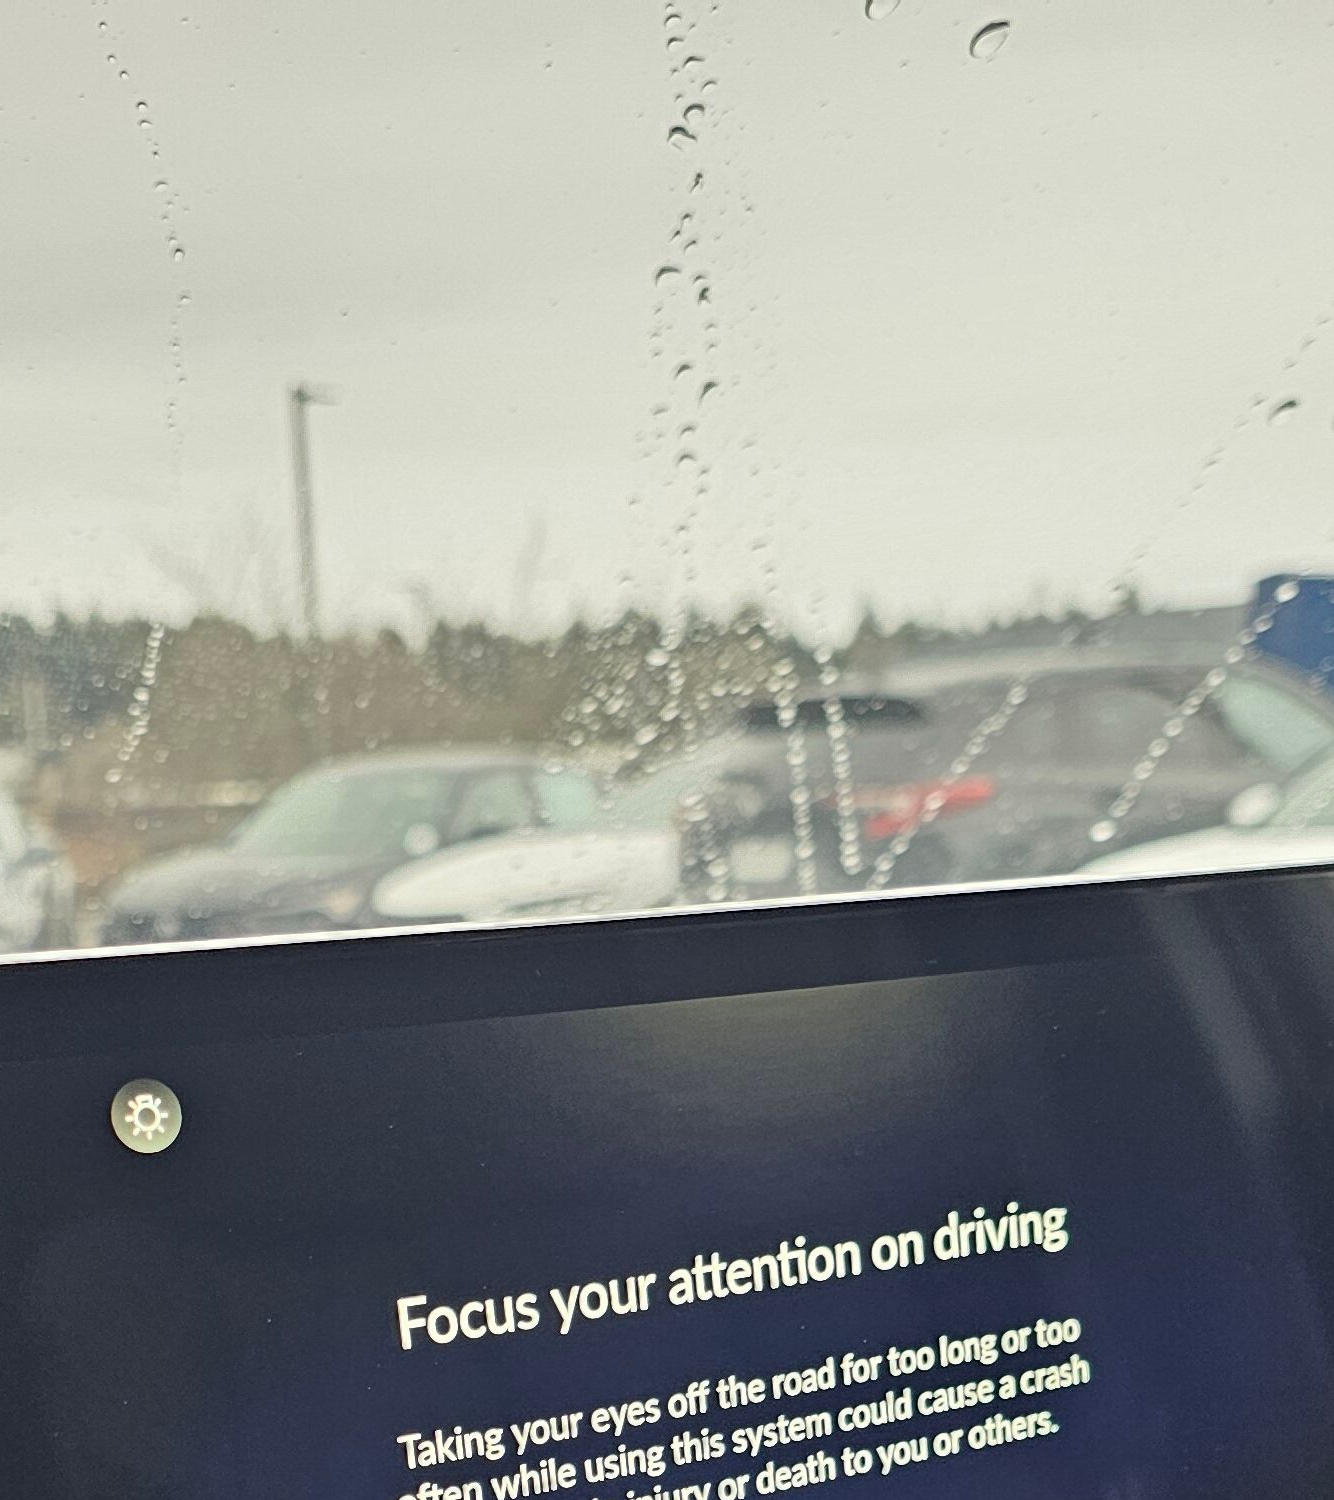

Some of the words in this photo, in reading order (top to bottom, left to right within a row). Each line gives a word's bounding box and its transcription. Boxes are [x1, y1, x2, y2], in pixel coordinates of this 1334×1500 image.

[396, 1294, 540, 1350] Focus
[549, 1273, 657, 1335] your
[668, 1235, 861, 1305] attention
[871, 1230, 924, 1271] on
[933, 1201, 1068, 1260] driving
[396, 1426, 505, 1469] Taking
[510, 1411, 583, 1455] your
[590, 1397, 661, 1436] eyes
[668, 1379, 709, 1418] off
[715, 1374, 766, 1409] the
[771, 1356, 836, 1400] road
[840, 1352, 883, 1386] for
[887, 1346, 935, 1377] too
[938, 1335, 998, 1366] long
[1000, 1326, 1032, 1355] or
[1034, 1318, 1082, 1348] too
[583, 1444, 666, 1482] using
[670, 1427, 725, 1466] this
[731, 1411, 832, 1457] system
[837, 1387, 913, 1431] could
[916, 1378, 995, 1416] cause
[998, 1375, 1017, 1400] a
[1019, 1353, 1091, 1396] crash
[755, 1450, 837, 1496] death
[841, 1446, 873, 1477] to
[876, 1436, 929, 1475] you
[932, 1428, 964, 1457] or
[967, 1410, 1060, 1450] others.
